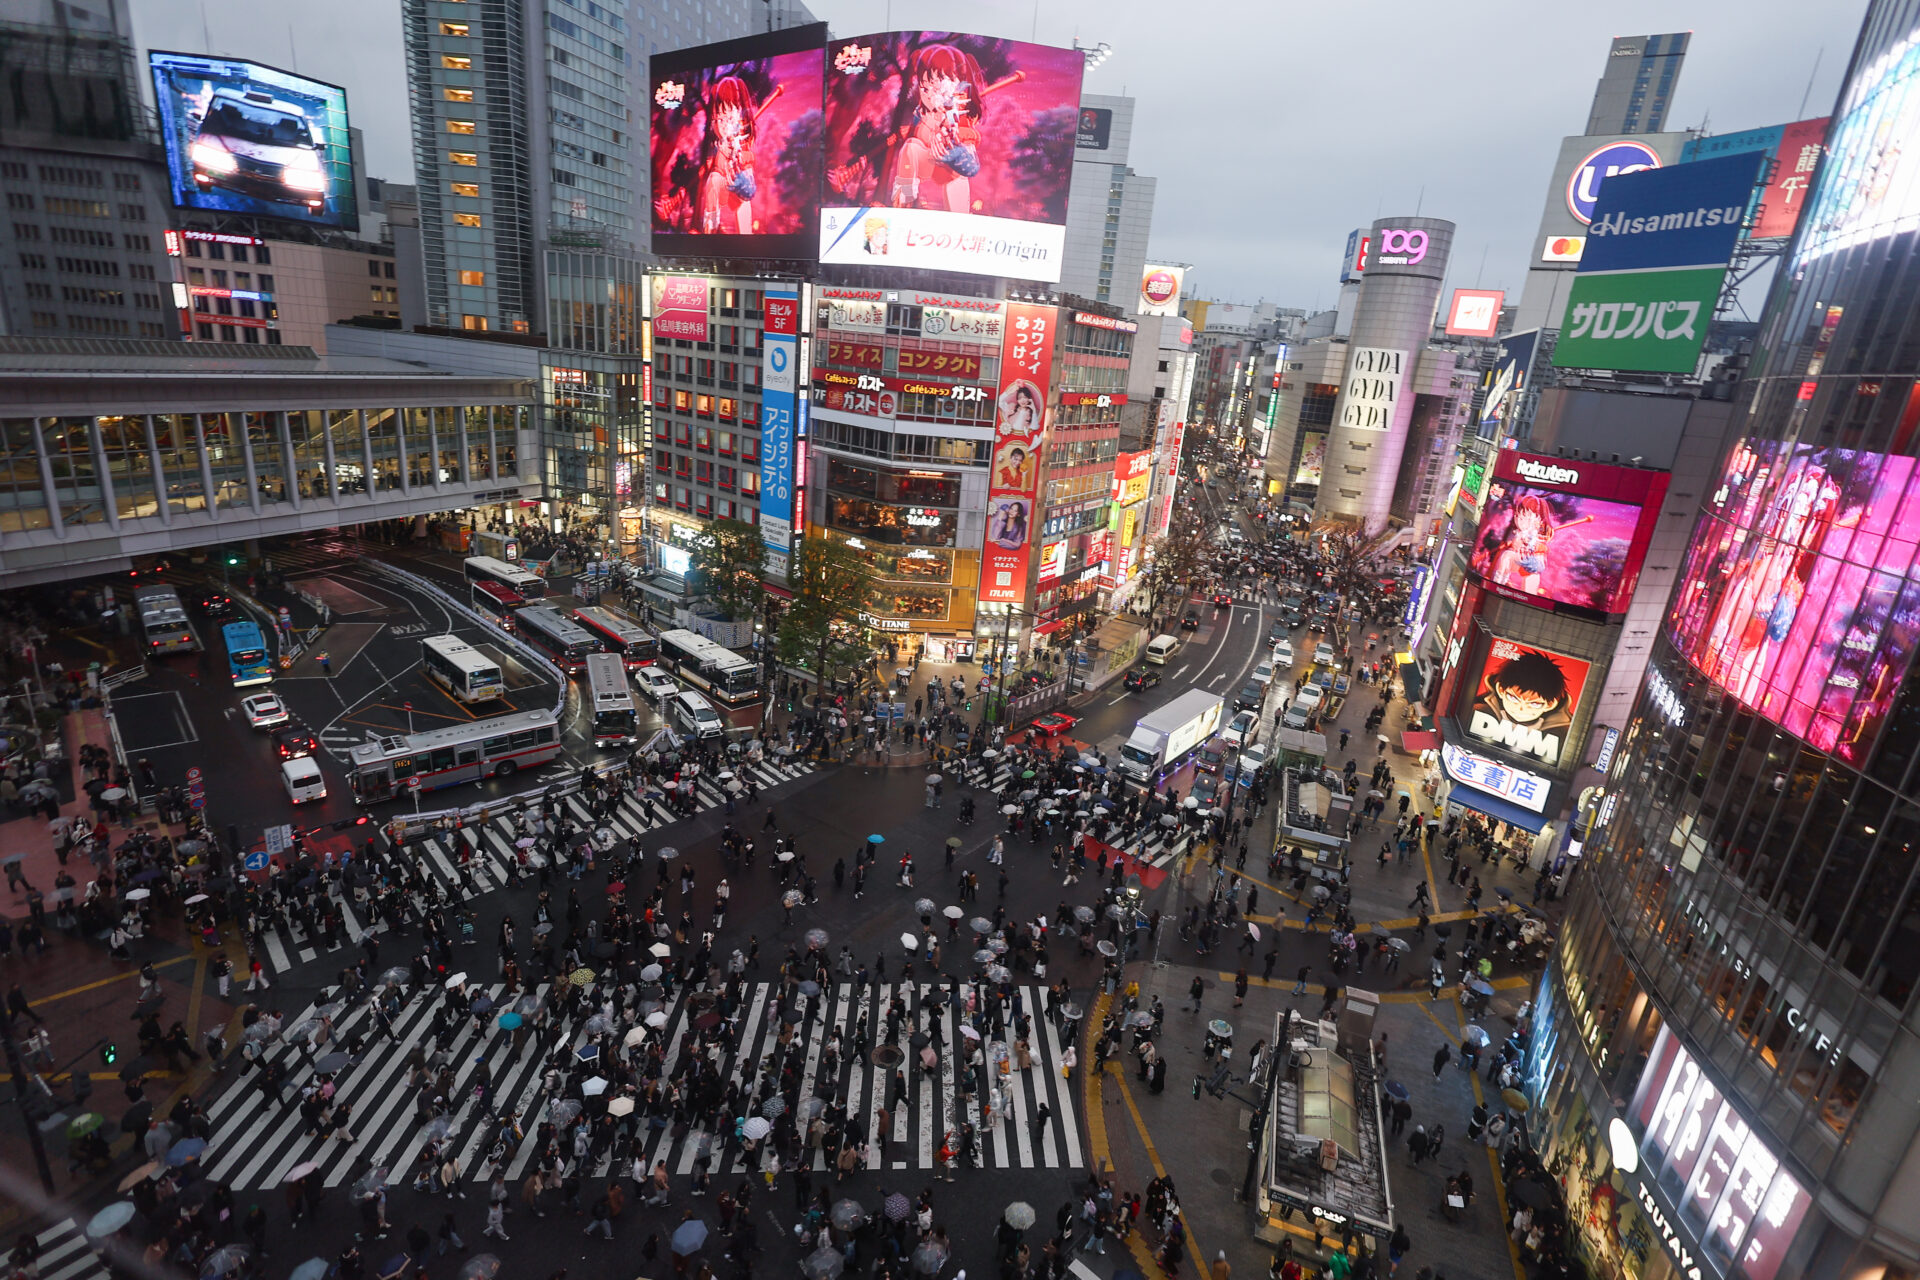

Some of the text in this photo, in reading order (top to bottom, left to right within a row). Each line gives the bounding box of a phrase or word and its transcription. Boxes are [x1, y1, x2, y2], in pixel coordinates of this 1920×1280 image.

[1589, 205, 1743, 237] Hisamitsu
[1381, 229, 1430, 265] 109
[769, 303, 792, 316] 当ビル
[817, 308, 829, 319] 9F
[848, 308, 884, 326] しゃぶ葉
[1569, 300, 1702, 341] サロンパス
[774, 317, 787, 329] 5F
[949, 315, 1001, 336] しゃぶ葉
[1012, 316, 1030, 367] みっけ。
[1028, 317, 1047, 375] カワイイ
[829, 343, 979, 373] プライス コンタクト
[1355, 350, 1400, 375] GYDA
[814, 388, 827, 400] 7F
[857, 375, 885, 392] ガスト
[950, 385, 988, 402] ガスト
[1350, 378, 1394, 402] GYDA
[842, 391, 876, 413] ガスト
[1343, 404, 1388, 429] GYDA
[764, 406, 779, 497] アイシティ
[777, 409, 790, 500] コンタクトの
[1515, 458, 1579, 485] Rakuten
[1469, 709, 1560, 767] DMM
